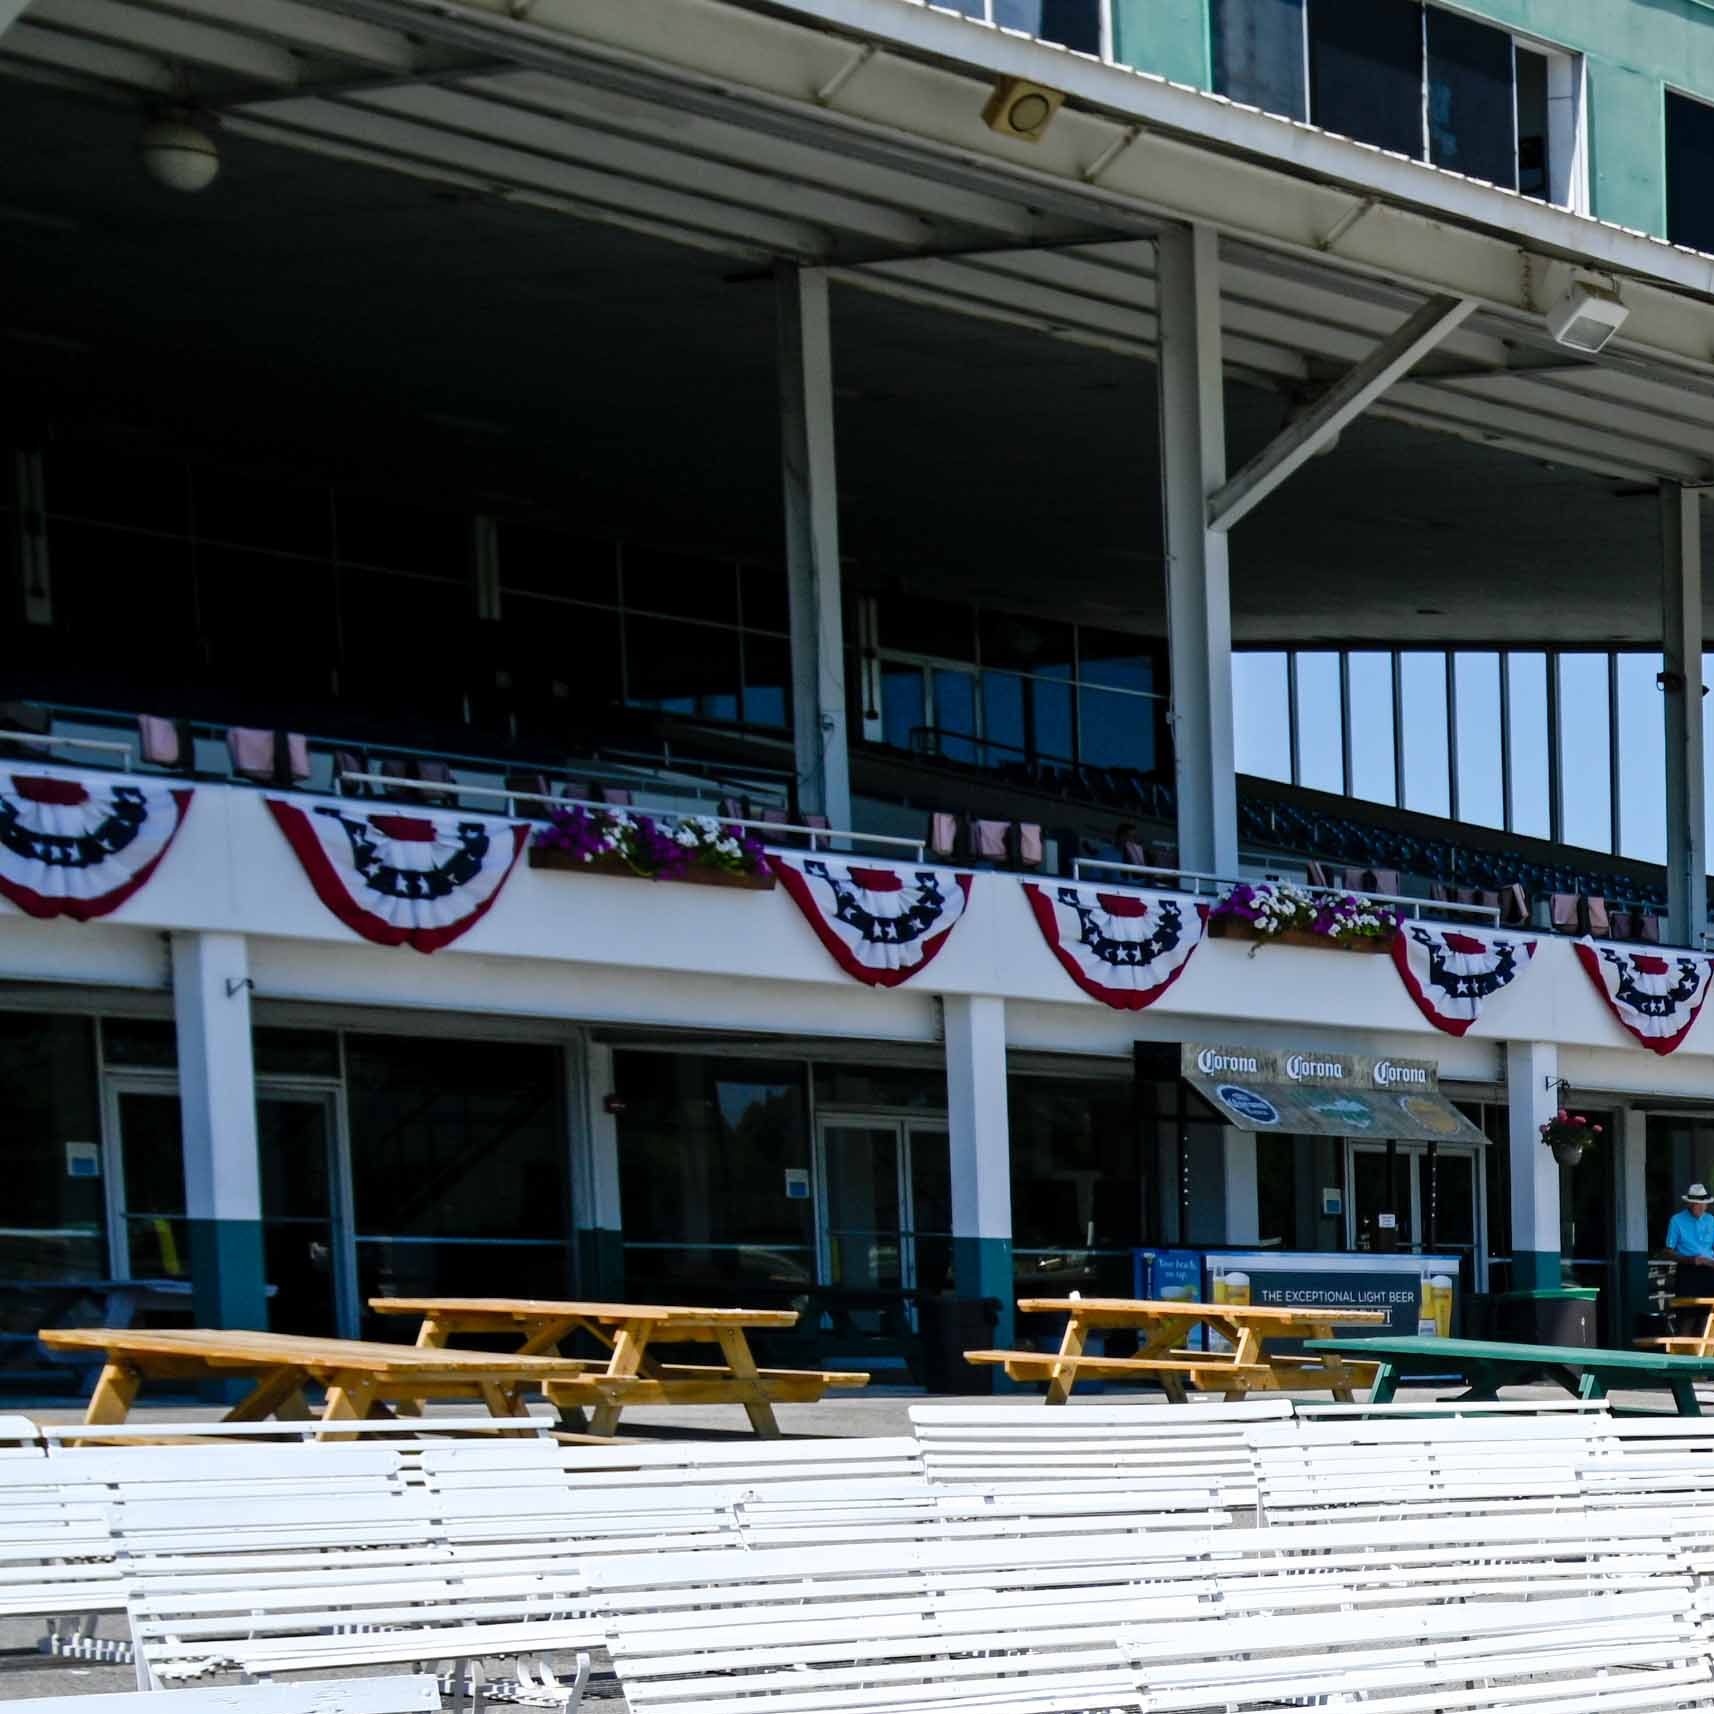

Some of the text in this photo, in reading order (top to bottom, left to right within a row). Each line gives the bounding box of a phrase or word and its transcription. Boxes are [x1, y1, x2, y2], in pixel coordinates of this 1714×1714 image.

[1198, 1048, 1257, 1076] Corona
[1286, 1055, 1344, 1082] Corona
[1373, 1060, 1427, 1087] Corona
[1262, 1290, 1415, 1303] THE EXCEPTIONAL LIGHT BEER
